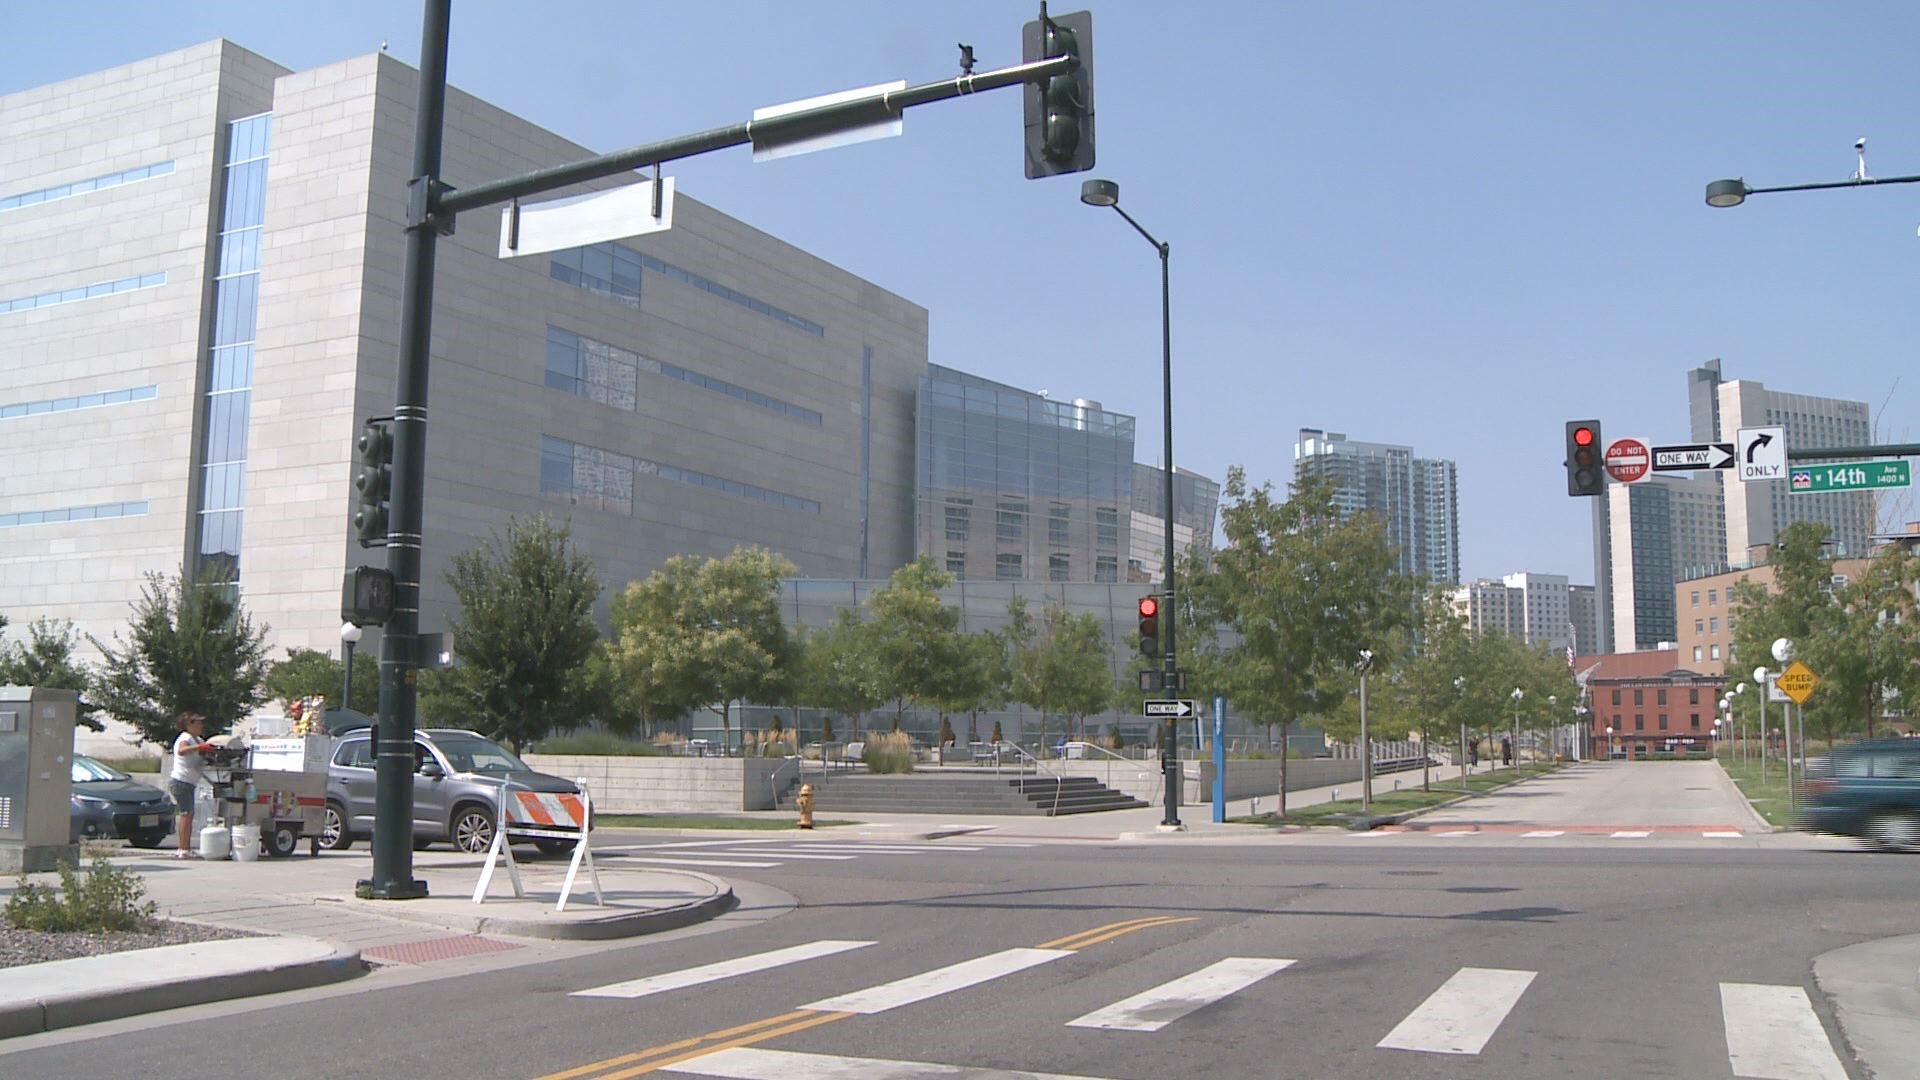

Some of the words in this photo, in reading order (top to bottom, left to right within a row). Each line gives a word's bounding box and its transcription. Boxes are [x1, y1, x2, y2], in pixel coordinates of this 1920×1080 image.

[1610, 447, 1622, 456] DO
[1627, 446, 1643, 455] NOT
[1659, 453, 1681, 464] ONE
[1686, 452, 1709, 463] WAY
[1614, 466, 1641, 475] ENTER
[1746, 465, 1780, 477] ONLY
[1884, 465, 1898, 473] Ave
[1827, 467, 1867, 486] 14th
[1877, 475, 1897, 484] 1400
[1899, 474, 1905, 482] N
[1784, 674, 1813, 682] SPEED
[1786, 683, 1811, 691] BUMP
